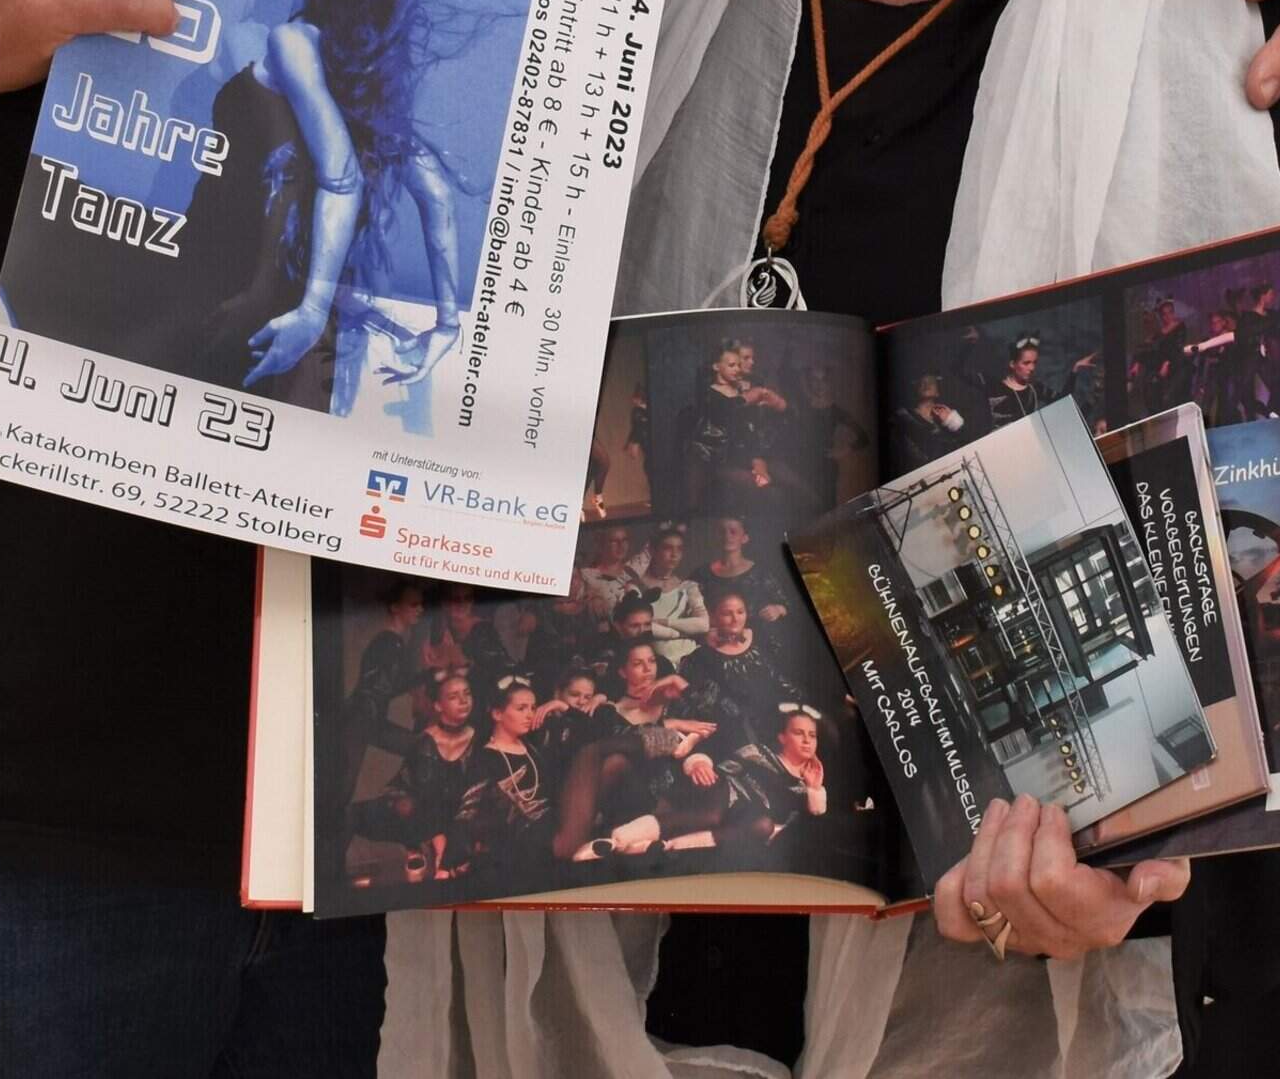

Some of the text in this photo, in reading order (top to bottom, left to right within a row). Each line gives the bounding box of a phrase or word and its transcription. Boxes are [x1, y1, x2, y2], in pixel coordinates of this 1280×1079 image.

[596, 22, 616, 38] h
[595, 47, 608, 60] +
[616, 32, 643, 92] Juni
[508, 28, 547, 158] 02402-87831
[548, 59, 567, 89] ab
[585, 71, 607, 97] 13
[543, 97, 562, 112] 8
[581, 103, 601, 118] h
[53, 73, 231, 177] Jahre
[538, 119, 558, 136] €
[580, 128, 592, 141] +
[602, 100, 632, 170] 2023
[569, 152, 592, 179] 15
[39, 156, 189, 258] Tanz
[520, 157, 551, 235] Kinder
[565, 184, 586, 200] h
[512, 240, 534, 271] ab
[549, 223, 576, 295] Einlass
[458, 174, 518, 428] info@ballett-atelier.com
[509, 278, 529, 293] 4
[505, 300, 525, 318] €
[542, 308, 562, 332] 30
[533, 337, 558, 377] Min.
[59, 359, 176, 428] Juni
[195, 392, 276, 453] 23
[524, 386, 545, 449] vorher
[5, 423, 157, 478] Katakomben
[165, 465, 334, 520] Ballett-Atelier
[372, 449, 481, 480] mit Unterstützung von:
[111, 481, 146, 506] 69,
[153, 492, 229, 524] 52222
[235, 511, 343, 553] Stolberg
[423, 480, 568, 523] VR-Bank eG
[1136, 482, 1154, 520] DAS
[395, 527, 494, 559] Sparkasse
[393, 551, 558, 586] Gut für Kunst und Kultur.
[1159, 488, 1203, 663] VORBEREITUNGEN
[1184, 511, 1217, 627] BACKSTAGE
[868, 563, 982, 835] BÜHNENAUFBAU IM MUSEUM
[896, 688, 922, 727] 2014
[861, 660, 918, 779] MIT CARLOS
